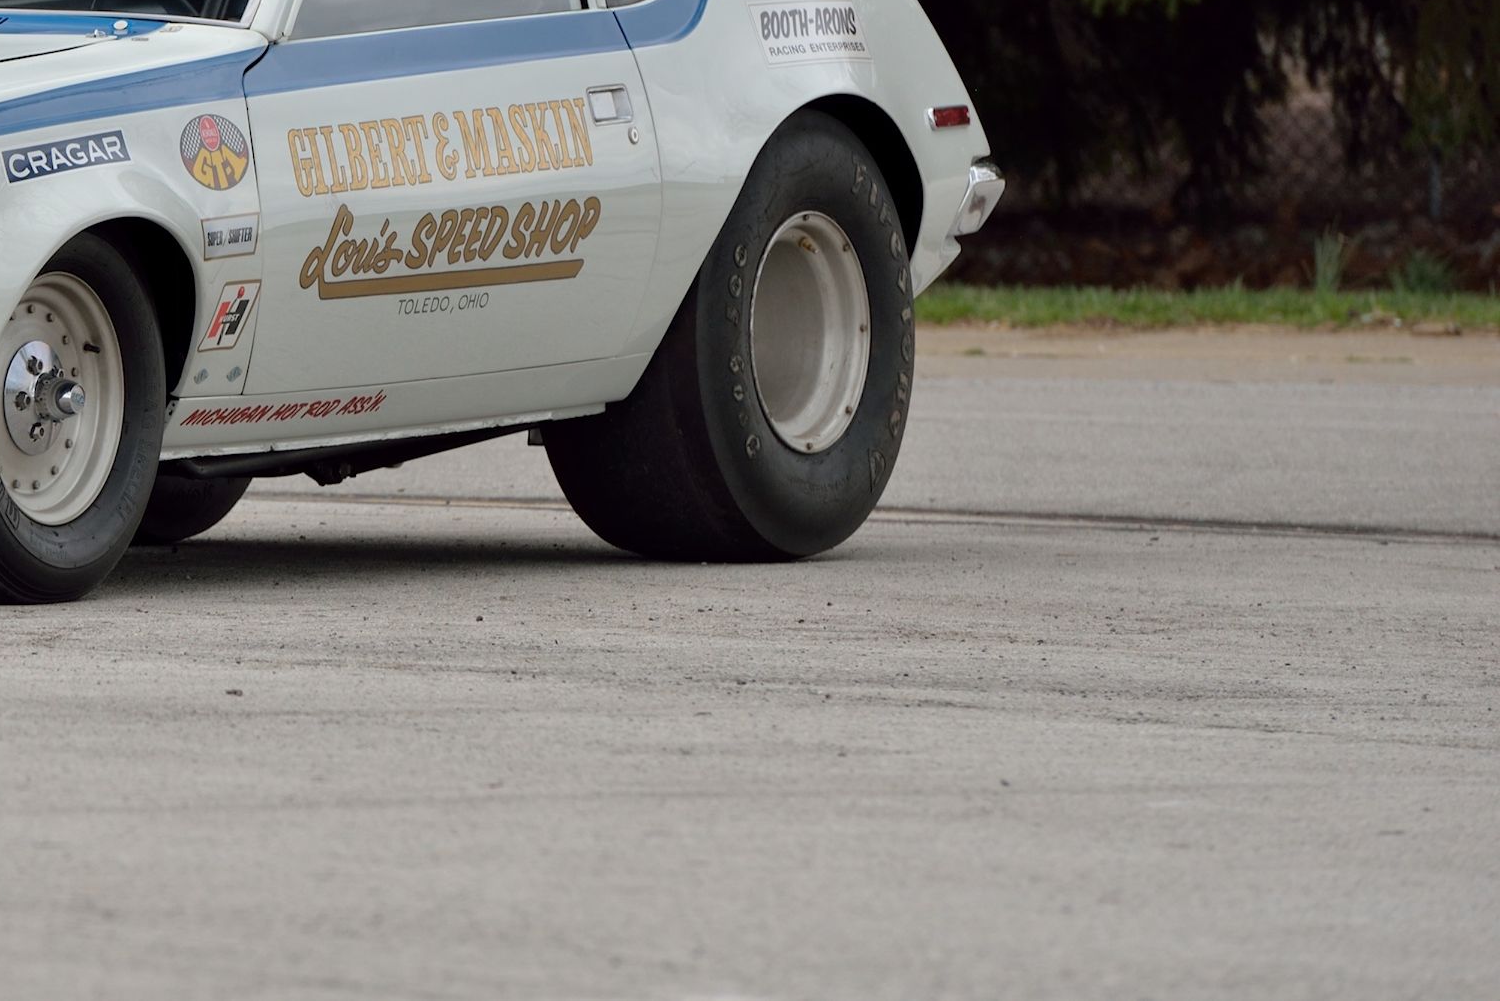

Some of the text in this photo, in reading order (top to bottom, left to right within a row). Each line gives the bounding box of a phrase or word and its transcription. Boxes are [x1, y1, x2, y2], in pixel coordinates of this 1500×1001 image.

[760, 6, 857, 41] BOOTH-ARONS
[768, 41, 866, 57] RACING ENTERPRISES
[8, 135, 125, 179] CRAGAR
[286, 98, 594, 197] GILBERT & MASKIN
[404, 205, 510, 269] SPEED
[503, 196, 602, 260] SHOP
[398, 292, 490, 316] TOLEDO, OHIO
[179, 405, 275, 427] MICHIGAN
[267, 402, 310, 422] HOT
[300, 399, 341, 419] ROD
